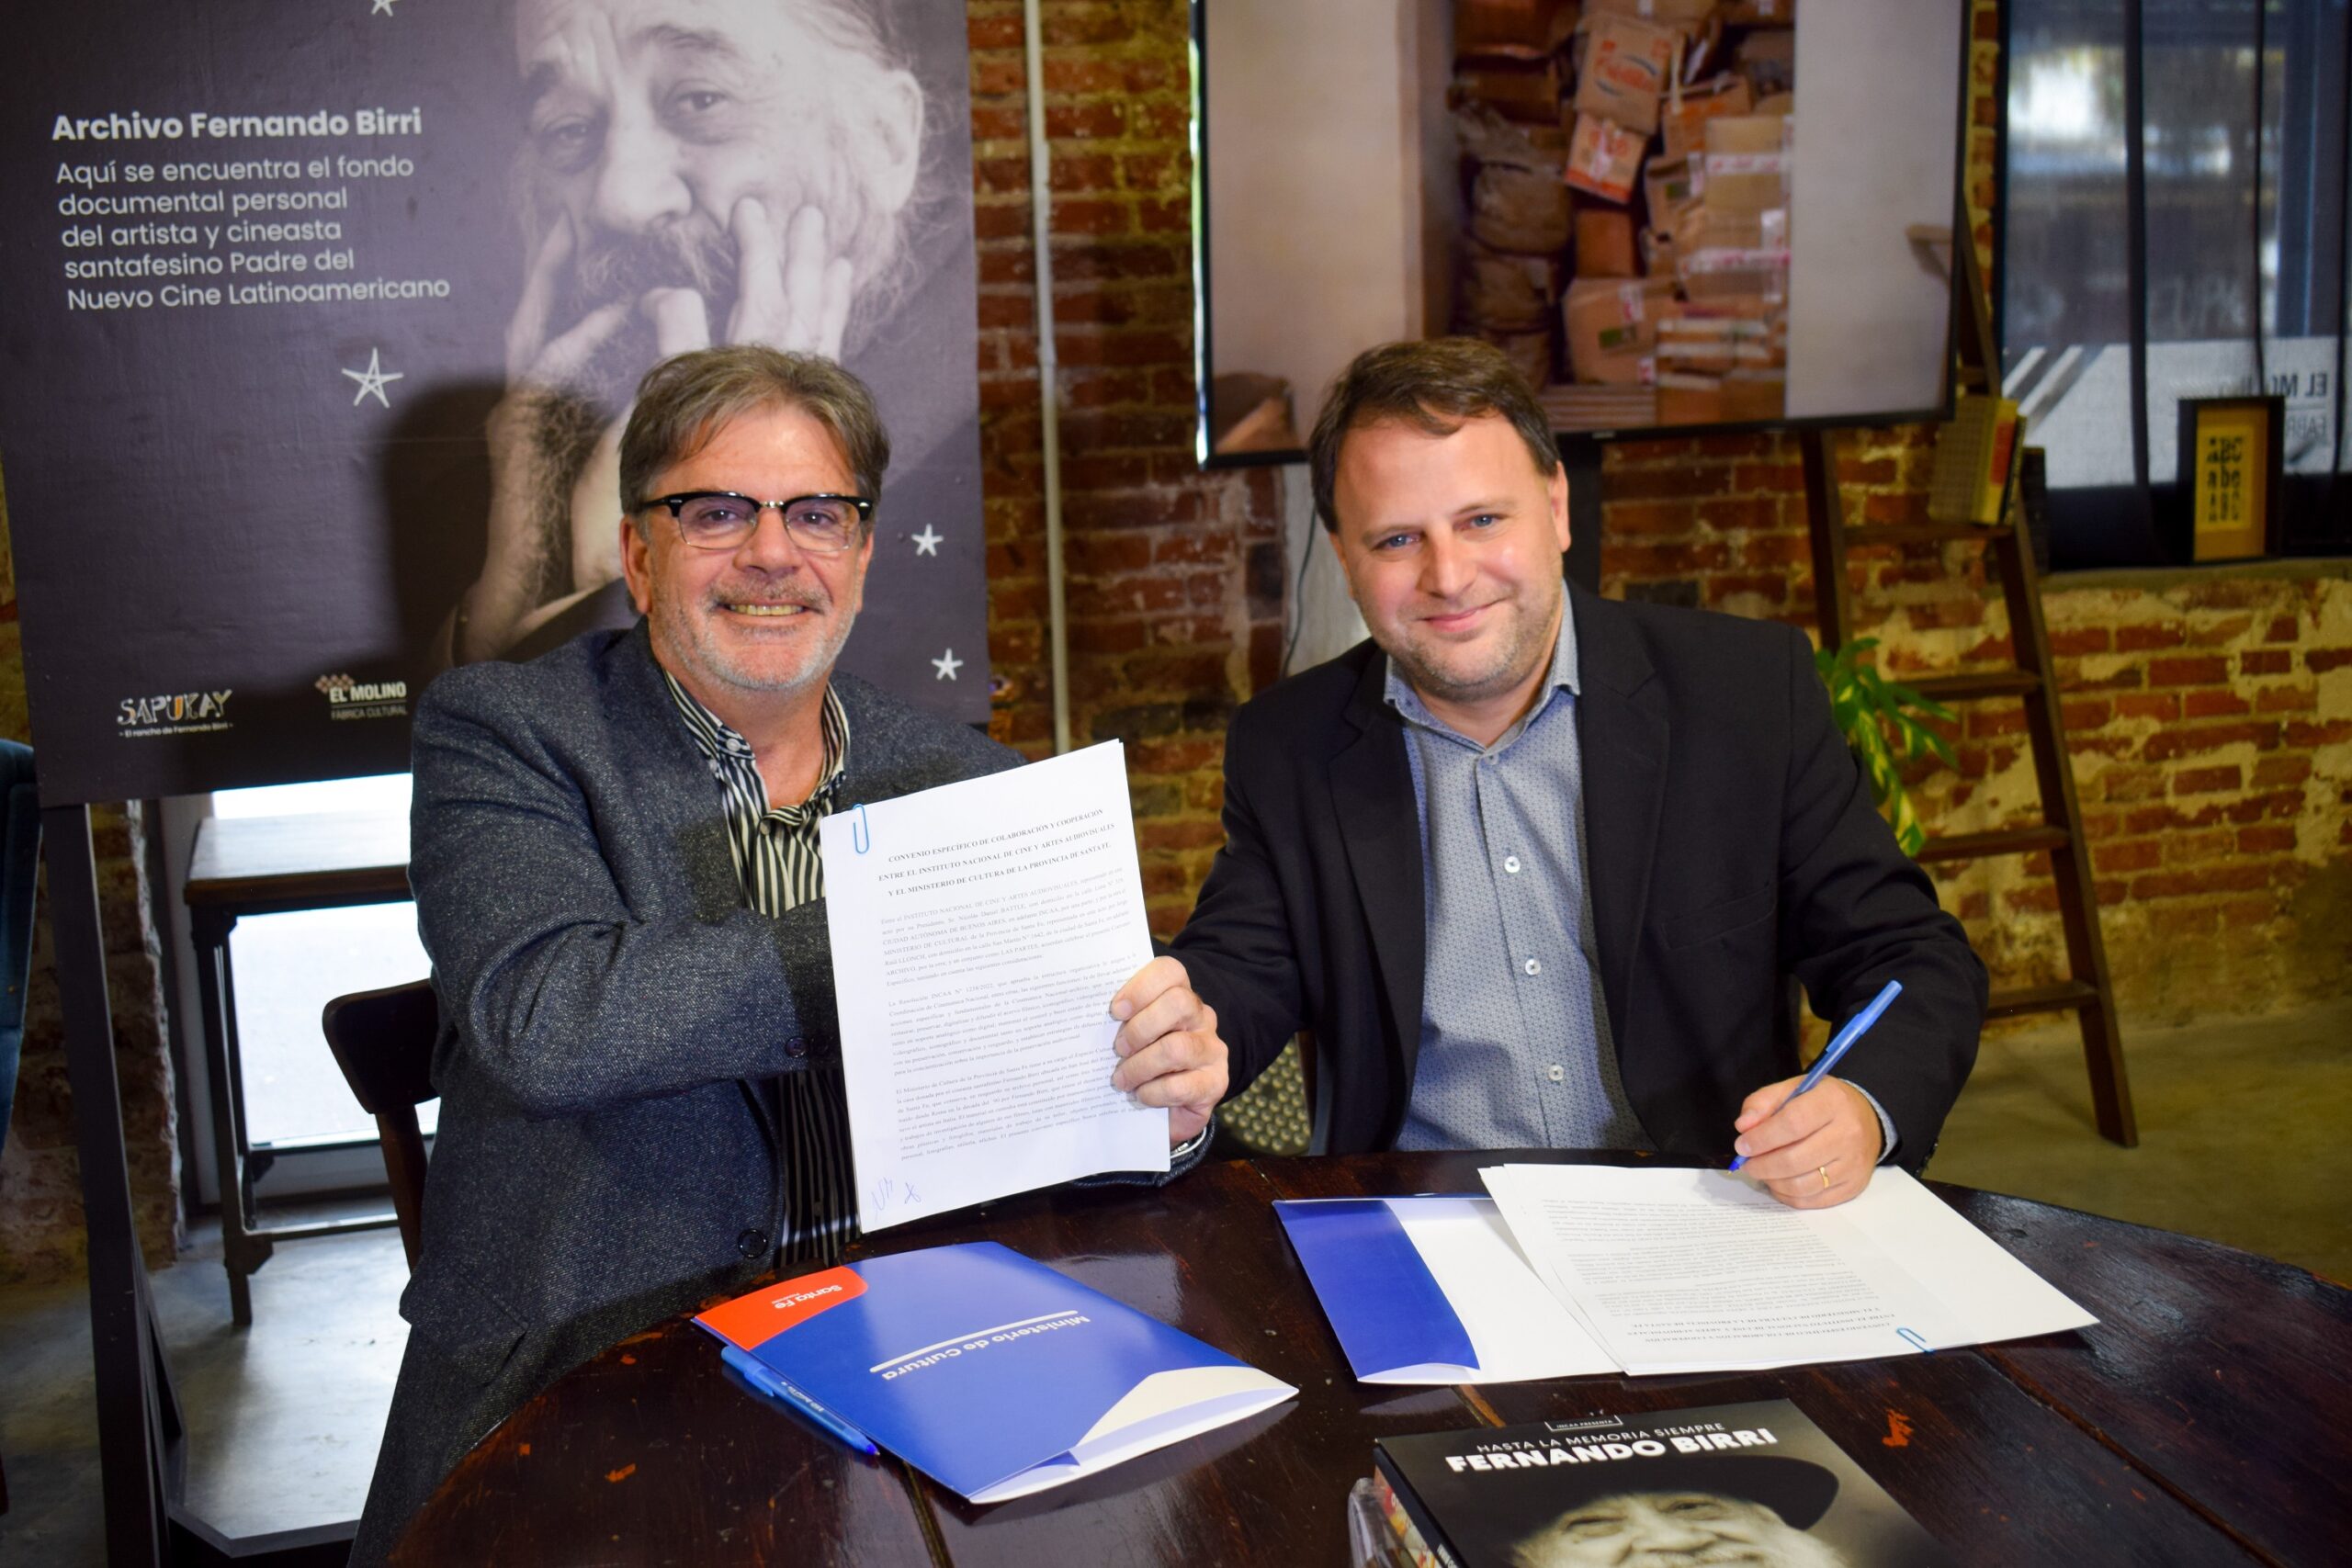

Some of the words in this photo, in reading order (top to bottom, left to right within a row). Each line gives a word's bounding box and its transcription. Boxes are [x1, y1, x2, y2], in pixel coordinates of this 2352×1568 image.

[51, 111, 183, 141] Archivo
[189, 110, 349, 139] Fernando
[356, 107, 423, 136] Birri
[55, 161, 117, 190] Aquí
[124, 163, 154, 182] se
[162, 159, 300, 182] encuentra
[308, 156, 330, 178] el
[337, 154, 414, 178] fondo
[58, 190, 224, 217] documental
[232, 186, 347, 218] personal
[62, 223, 103, 248] del
[111, 222, 198, 246] artista
[205, 226, 219, 249] y
[227, 219, 342, 243] cineasta
[64, 254, 223, 279] santafesino
[230, 250, 308, 275] Padre
[314, 248, 355, 271] del
[67, 287, 153, 310] Nuevo
[161, 282, 221, 307] Cine
[229, 276, 450, 306] Latinoamericano
[118, 689, 232, 725] SAPUKAY
[329, 686, 347, 703] EL
[350, 681, 407, 702] MOLINO
[878, 872, 904, 882] ENTRE
[919, 861, 961, 874] INSTITUTO
[962, 853, 1001, 866] NACIONAL
[1014, 846, 1032, 855] CINE
[1041, 838, 1063, 849] ARTES
[888, 851, 931, 863] CONVENIO
[907, 880, 955, 893] MINISTERIO
[968, 870, 1004, 882] CULTURA
[1029, 853, 1069, 869] PROVINCIA
[775, 1300, 796, 1309] Fe
[795, 1284, 842, 1303] Santa
[992, 1315, 1091, 1344] Ministerio
[964, 1338, 989, 1353] de
[881, 1347, 962, 1381] Cultura
[1445, 1439, 1667, 1472] FERNANDO
[1670, 1428, 1778, 1454] BIRRI
[1476, 1439, 1532, 1453] HASTA
[1539, 1438, 1561, 1448] LA
[1566, 1430, 1650, 1445] MEMORIA
[1654, 1423, 1725, 1437] SIEMPRE
